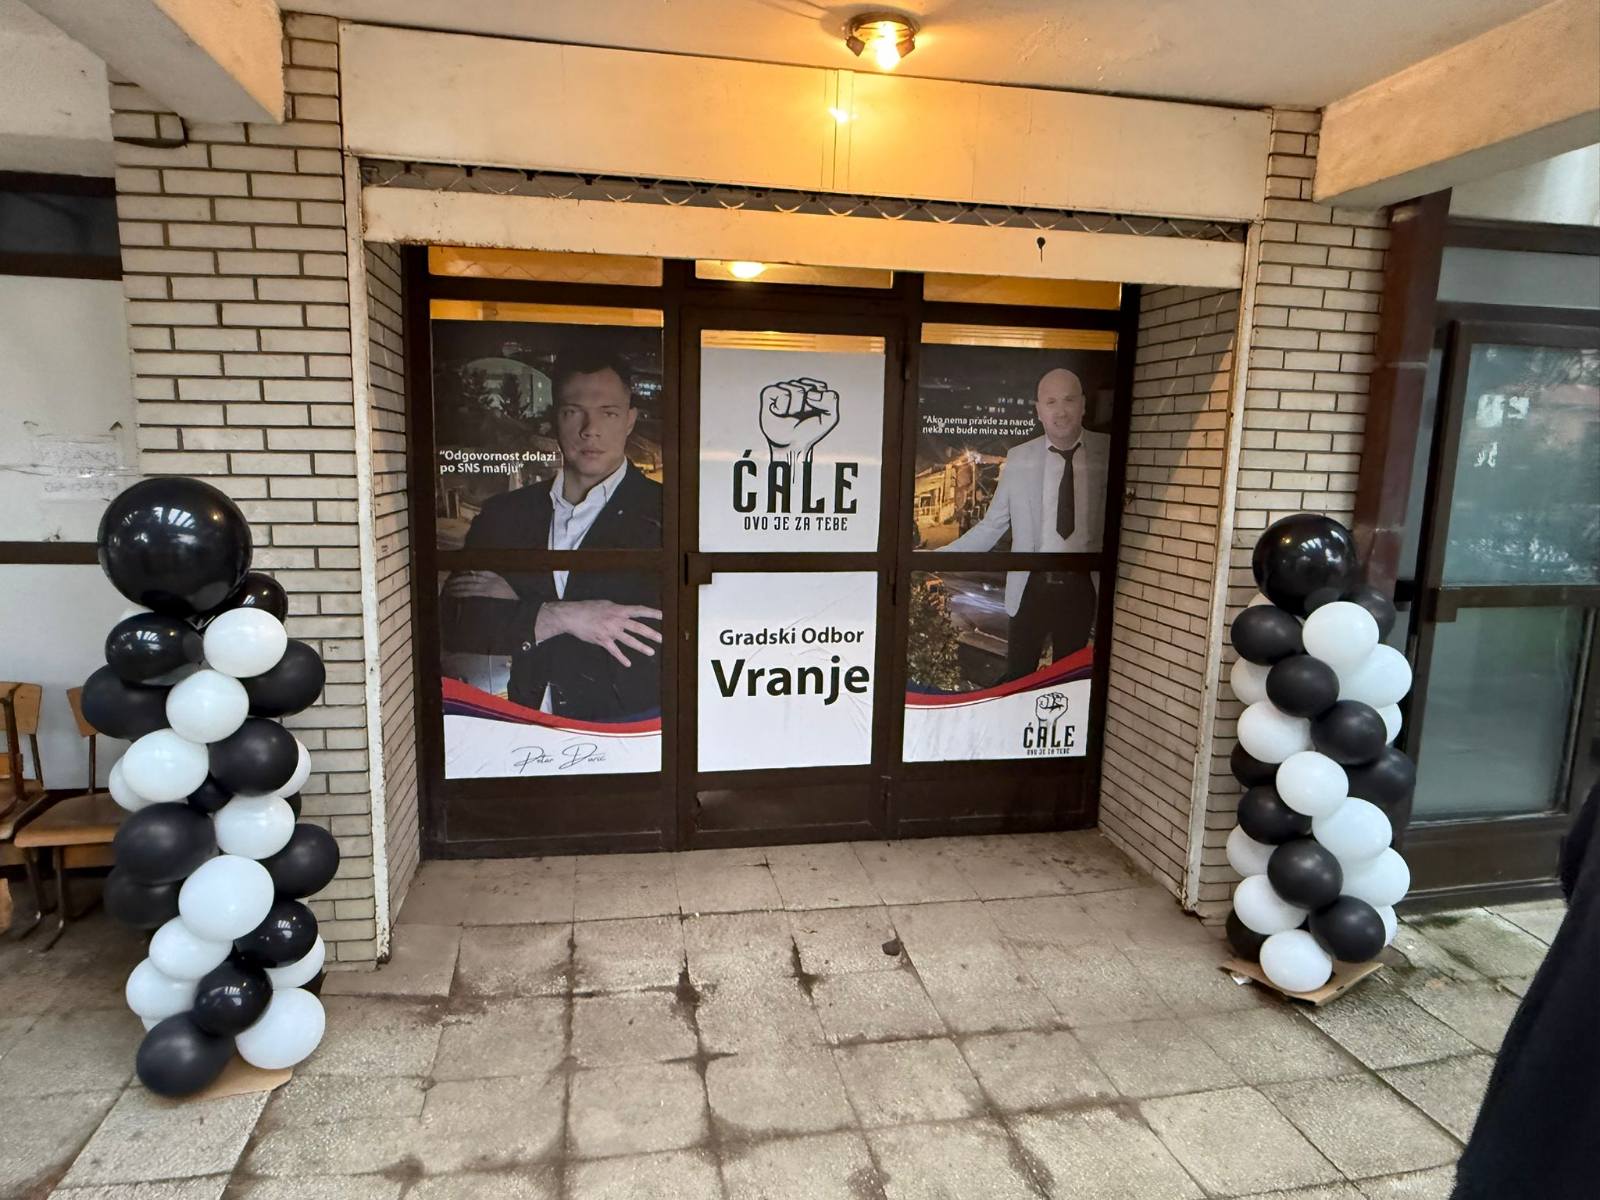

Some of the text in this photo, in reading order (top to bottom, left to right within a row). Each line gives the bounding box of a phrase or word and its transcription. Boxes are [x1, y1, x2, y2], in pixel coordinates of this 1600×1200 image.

[998, 418, 1009, 426] za
[922, 426, 943, 434] neka
[956, 426, 978, 435] bude
[979, 427, 998, 435] mira
[999, 428, 1009, 436] za
[521, 451, 556, 462] dolazi
[439, 464, 455, 475] po
[457, 463, 480, 473] SNS
[733, 449, 859, 514] ĆALE
[744, 516, 848, 531] OVO JE ZA TEBE
[719, 626, 865, 645] Gradski Odbor
[711, 655, 870, 705] Vranje
[1023, 721, 1075, 748] ĆALE
